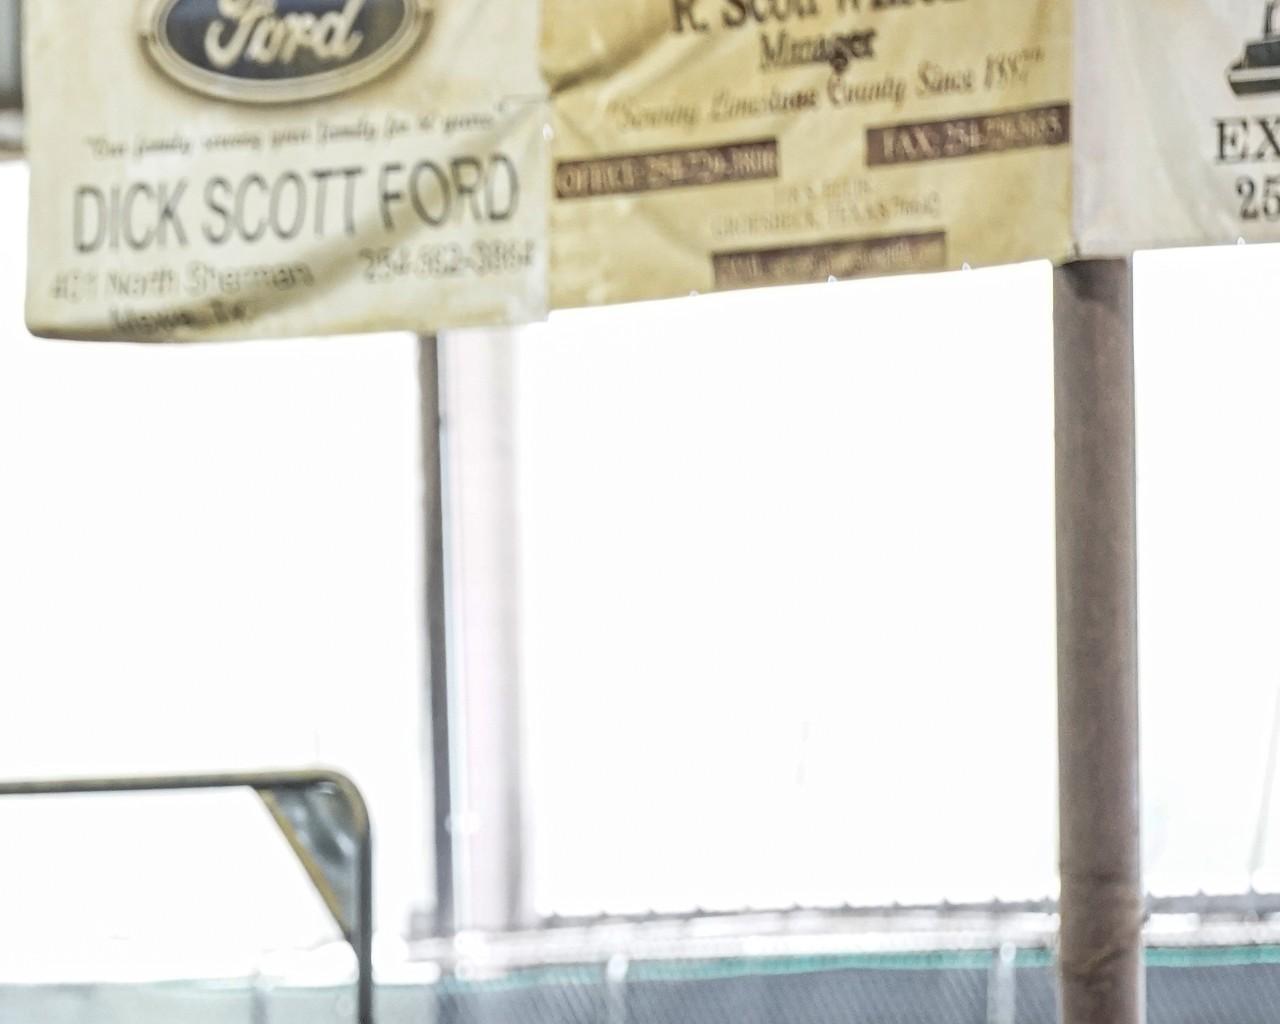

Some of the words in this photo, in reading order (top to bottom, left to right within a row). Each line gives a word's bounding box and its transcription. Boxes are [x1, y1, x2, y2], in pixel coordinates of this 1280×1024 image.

[204, 0, 366, 69] Ford
[73, 180, 192, 256] DICK
[201, 166, 368, 246] SCOTT
[378, 152, 521, 234] FORD
[107, 267, 175, 299] North
